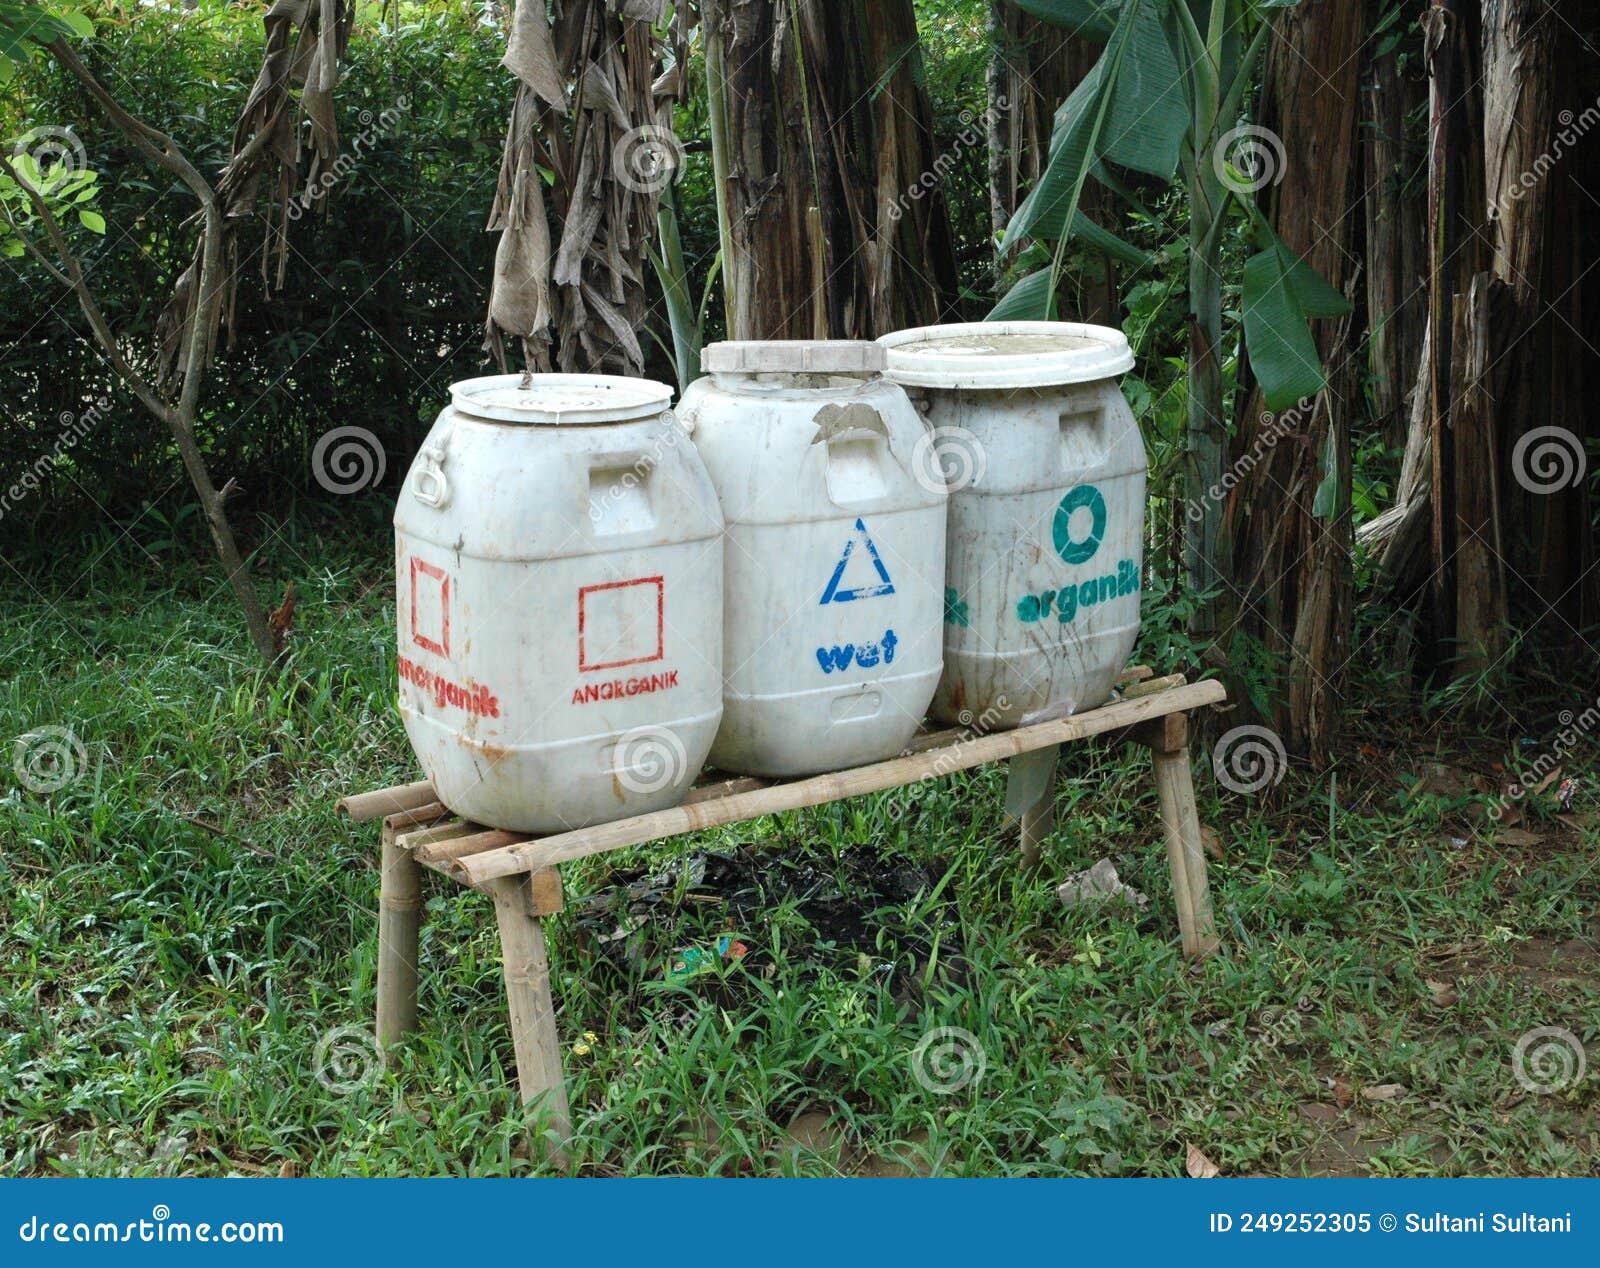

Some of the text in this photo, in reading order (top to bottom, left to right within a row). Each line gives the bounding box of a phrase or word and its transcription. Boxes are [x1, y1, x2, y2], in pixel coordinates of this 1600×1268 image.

[1016, 559, 1140, 624] organik
[816, 629, 898, 674] wet
[571, 669, 678, 705] ANORGANIK
